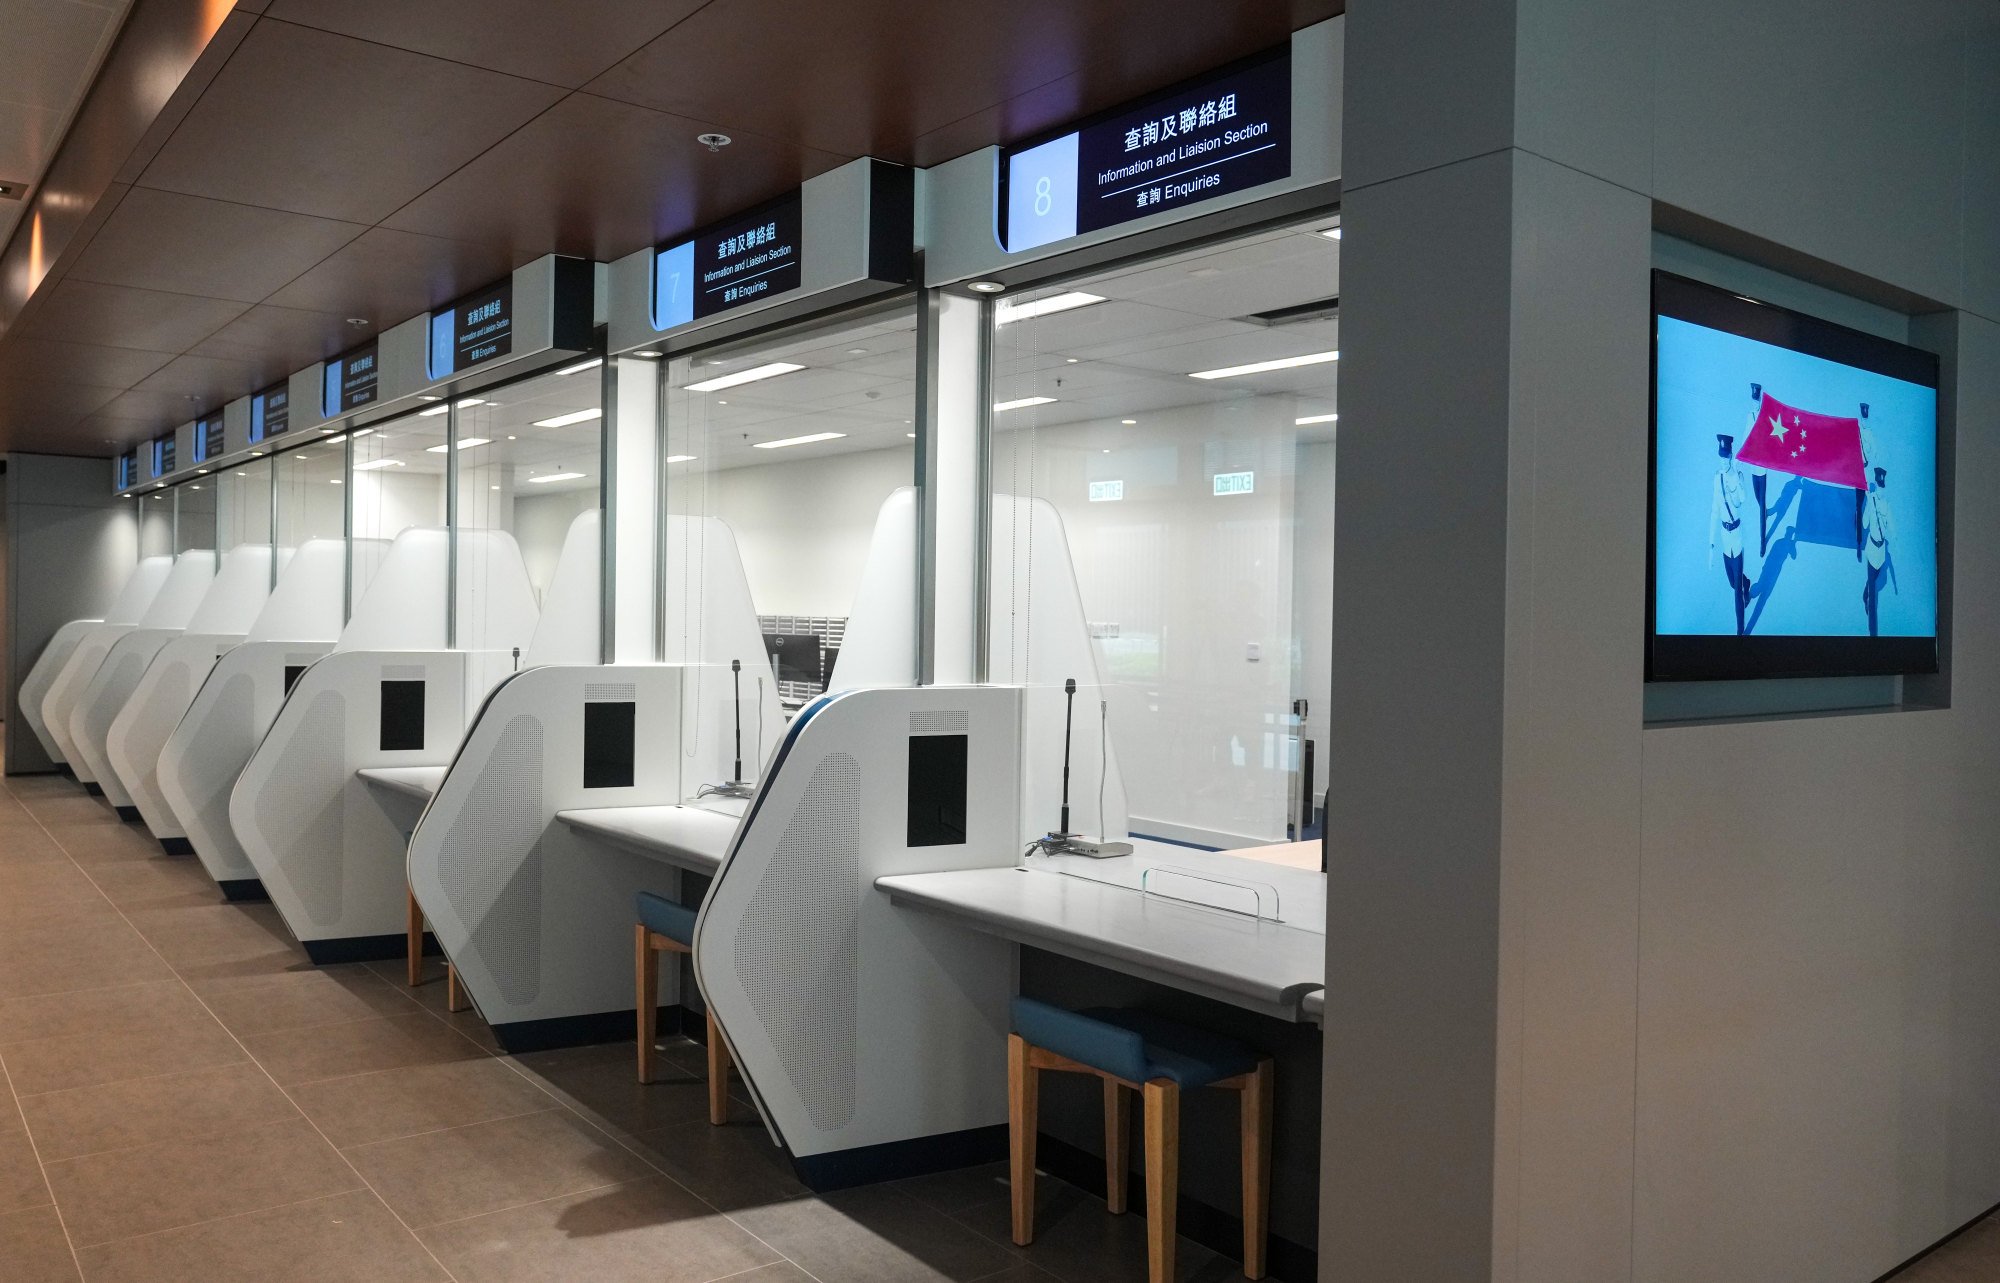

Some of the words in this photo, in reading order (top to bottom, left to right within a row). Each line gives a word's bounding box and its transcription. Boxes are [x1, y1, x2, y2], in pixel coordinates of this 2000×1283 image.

[1124, 93, 1237, 152] 查詢及聯絡組
[1098, 157, 1153, 185] Information
[1156, 150, 1176, 168] and
[1179, 135, 1221, 160] Liaision
[1224, 122, 1268, 145] Section
[1034, 176, 1051, 217] 8
[1136, 188, 1161, 208] 查詢
[1165, 173, 1220, 199] Enquiries
[717, 222, 776, 260] 查詢及聯絡組
[704, 262, 734, 283] Information
[734, 259, 745, 273] and
[769, 245, 792, 260] Section
[670, 272, 681, 304] 7
[738, 280, 768, 297] Enquiries
